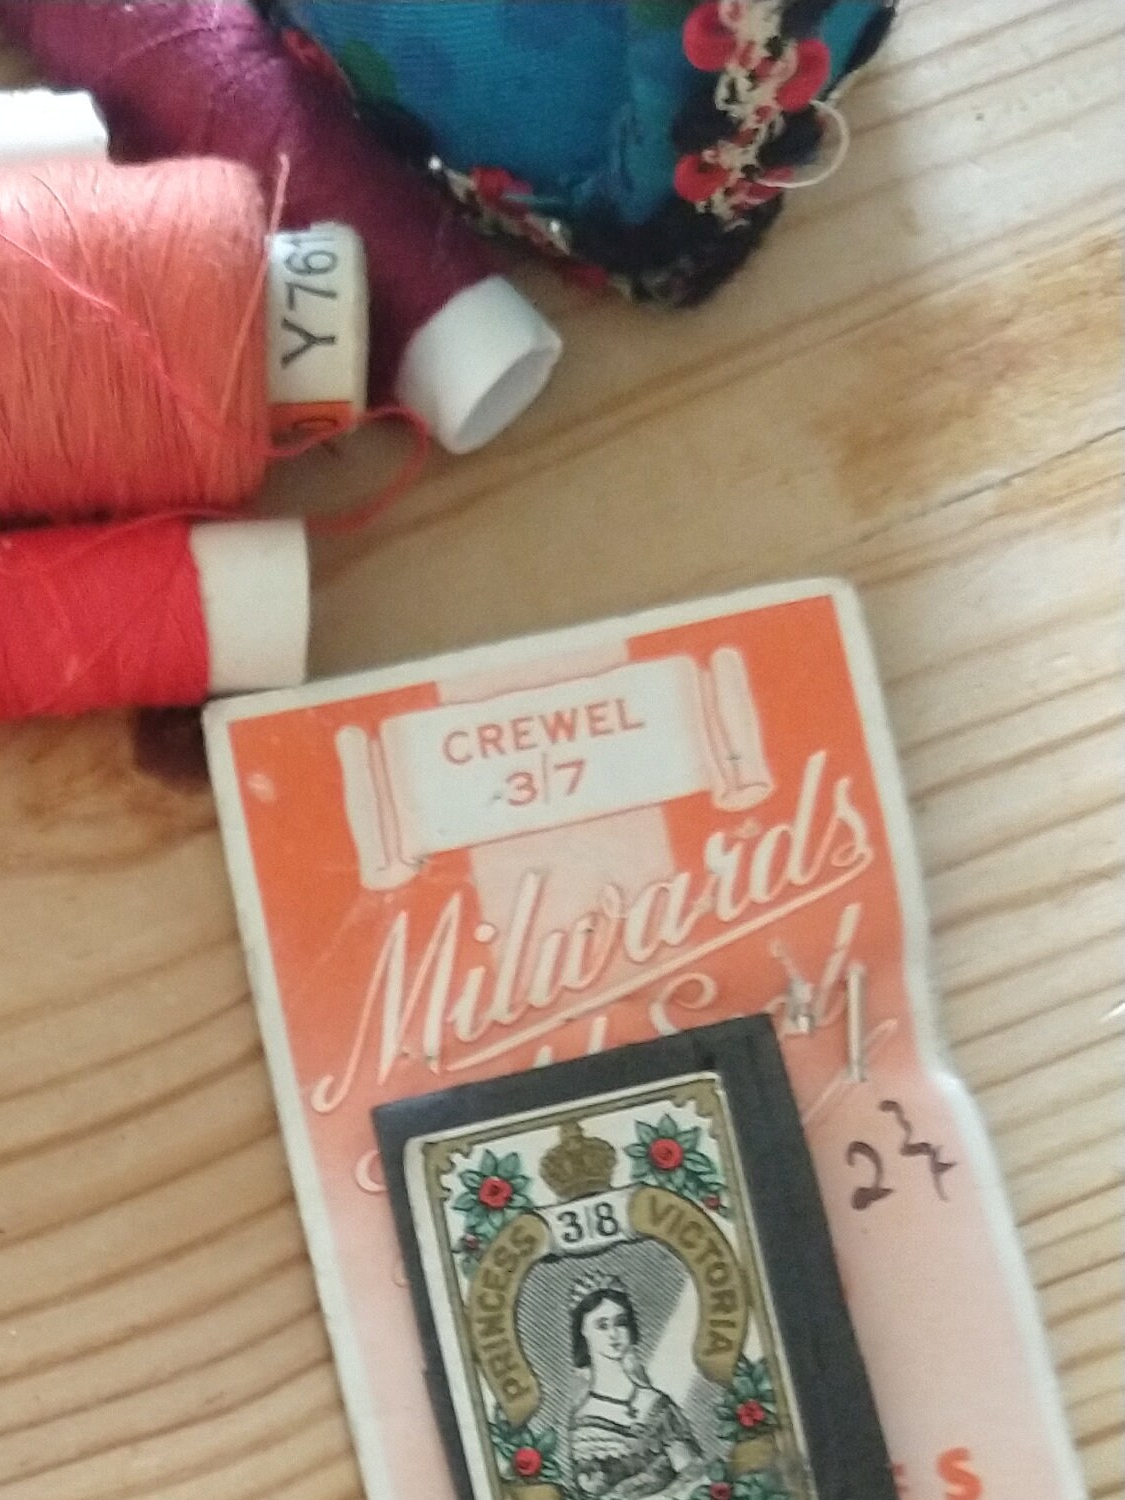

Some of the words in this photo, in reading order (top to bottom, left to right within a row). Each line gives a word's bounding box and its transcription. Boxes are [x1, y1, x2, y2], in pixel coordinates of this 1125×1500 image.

[442, 698, 646, 766] CREWEL
[311, 748, 875, 1113] Milwards
[475, 1224, 538, 1401] PRINCESS
[648, 1195, 739, 1357] VICTORIA
